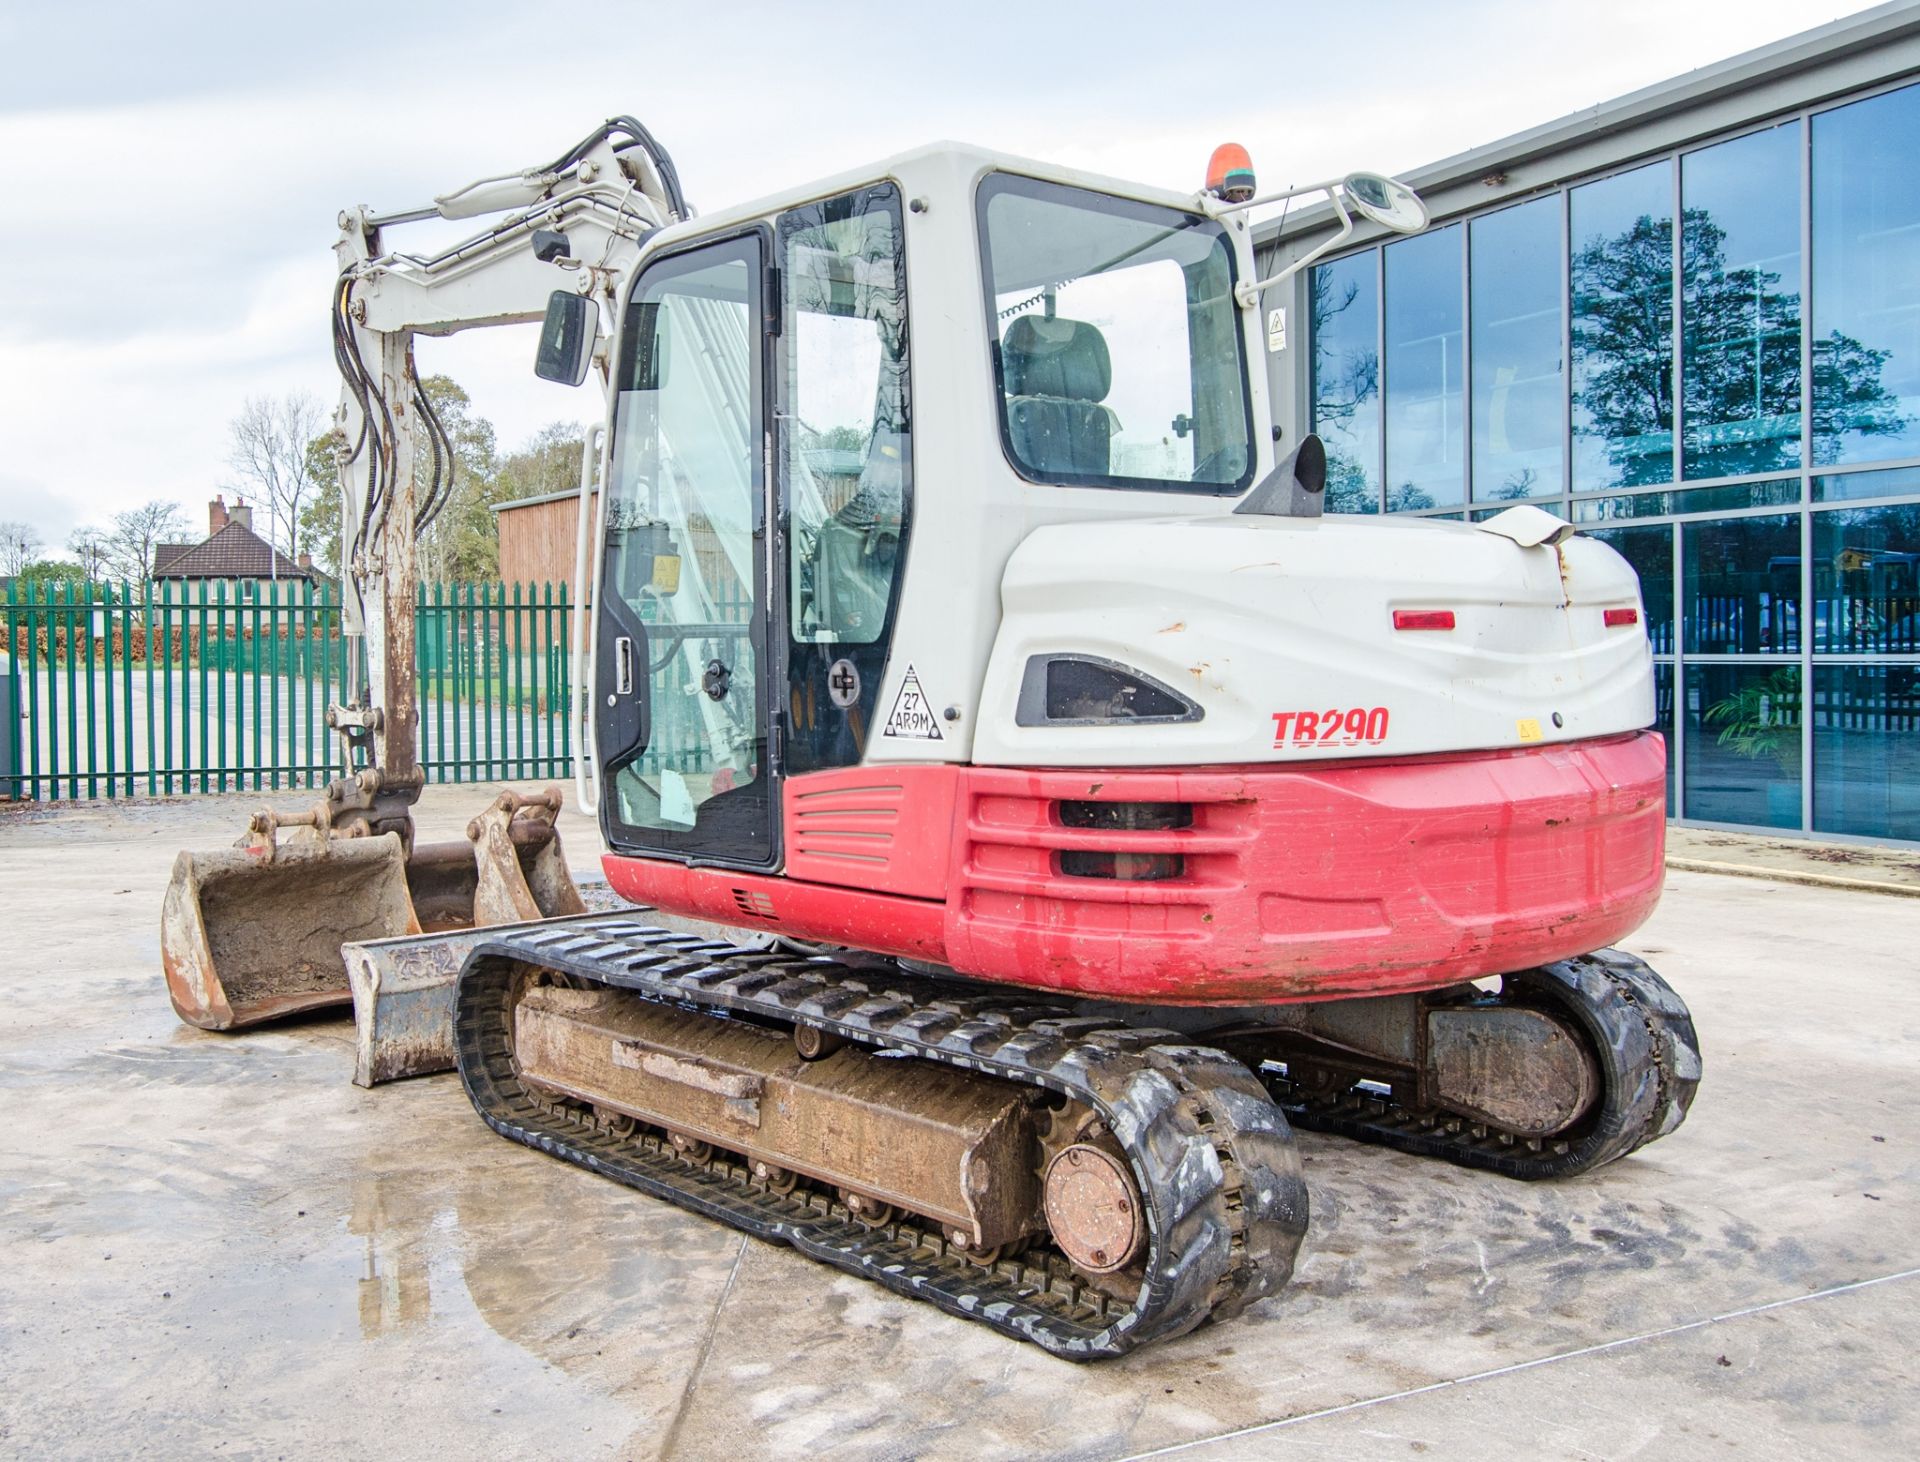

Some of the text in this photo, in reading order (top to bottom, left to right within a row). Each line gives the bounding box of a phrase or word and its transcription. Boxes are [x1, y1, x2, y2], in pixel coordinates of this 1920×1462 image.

[904, 692, 919, 710] 27
[895, 711, 929, 731] AR9M
[1272, 706, 1389, 749] TB290
